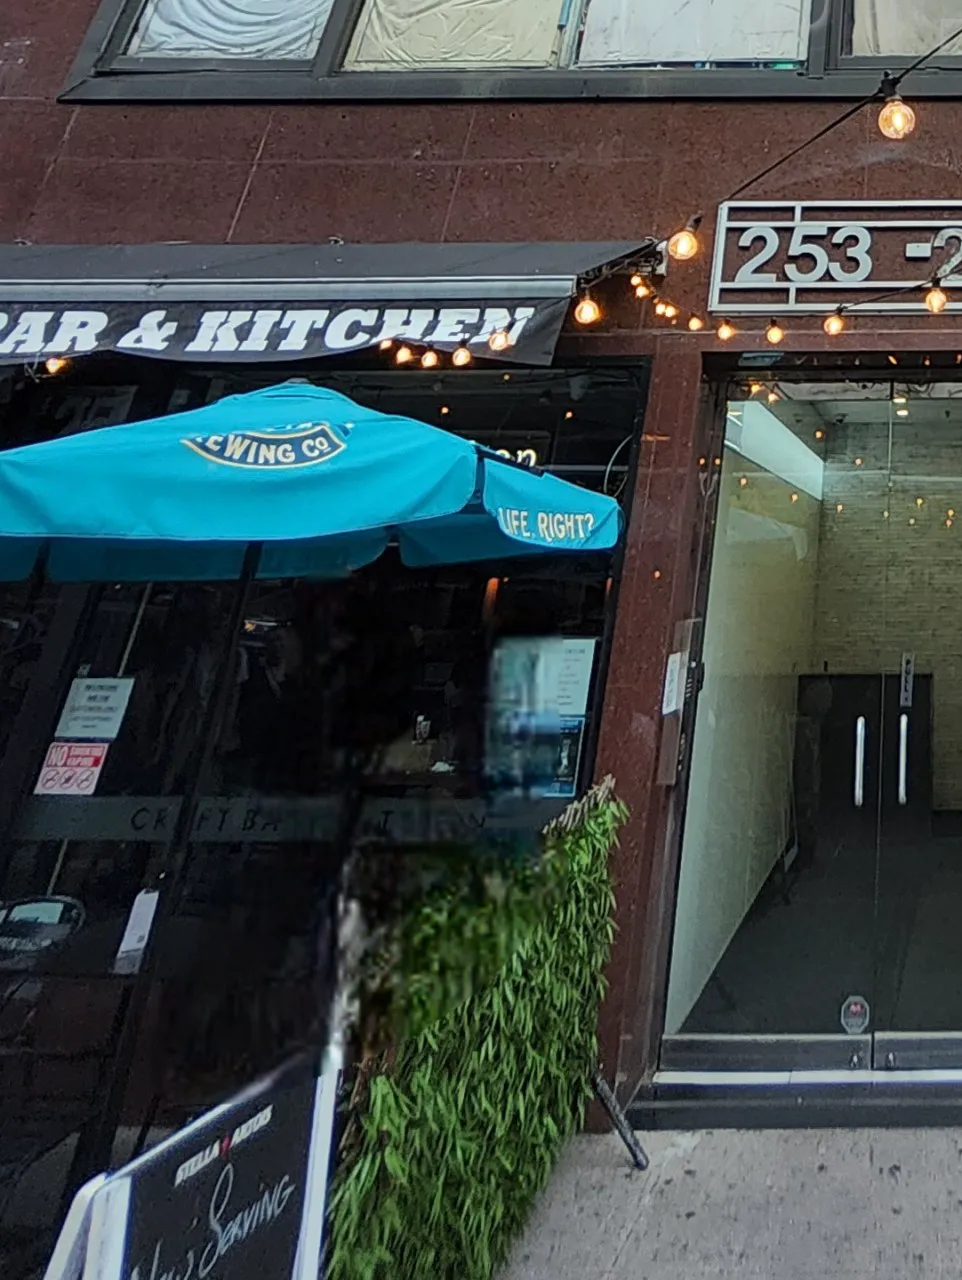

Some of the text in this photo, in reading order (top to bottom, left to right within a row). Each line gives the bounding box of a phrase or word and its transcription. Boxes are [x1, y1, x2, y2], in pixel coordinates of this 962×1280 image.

[734, 226, 873, 283] 253
[0, 306, 535, 353] AR & KITCHEN
[195, 432, 296, 464] EWING
[48, 745, 68, 766] NO
